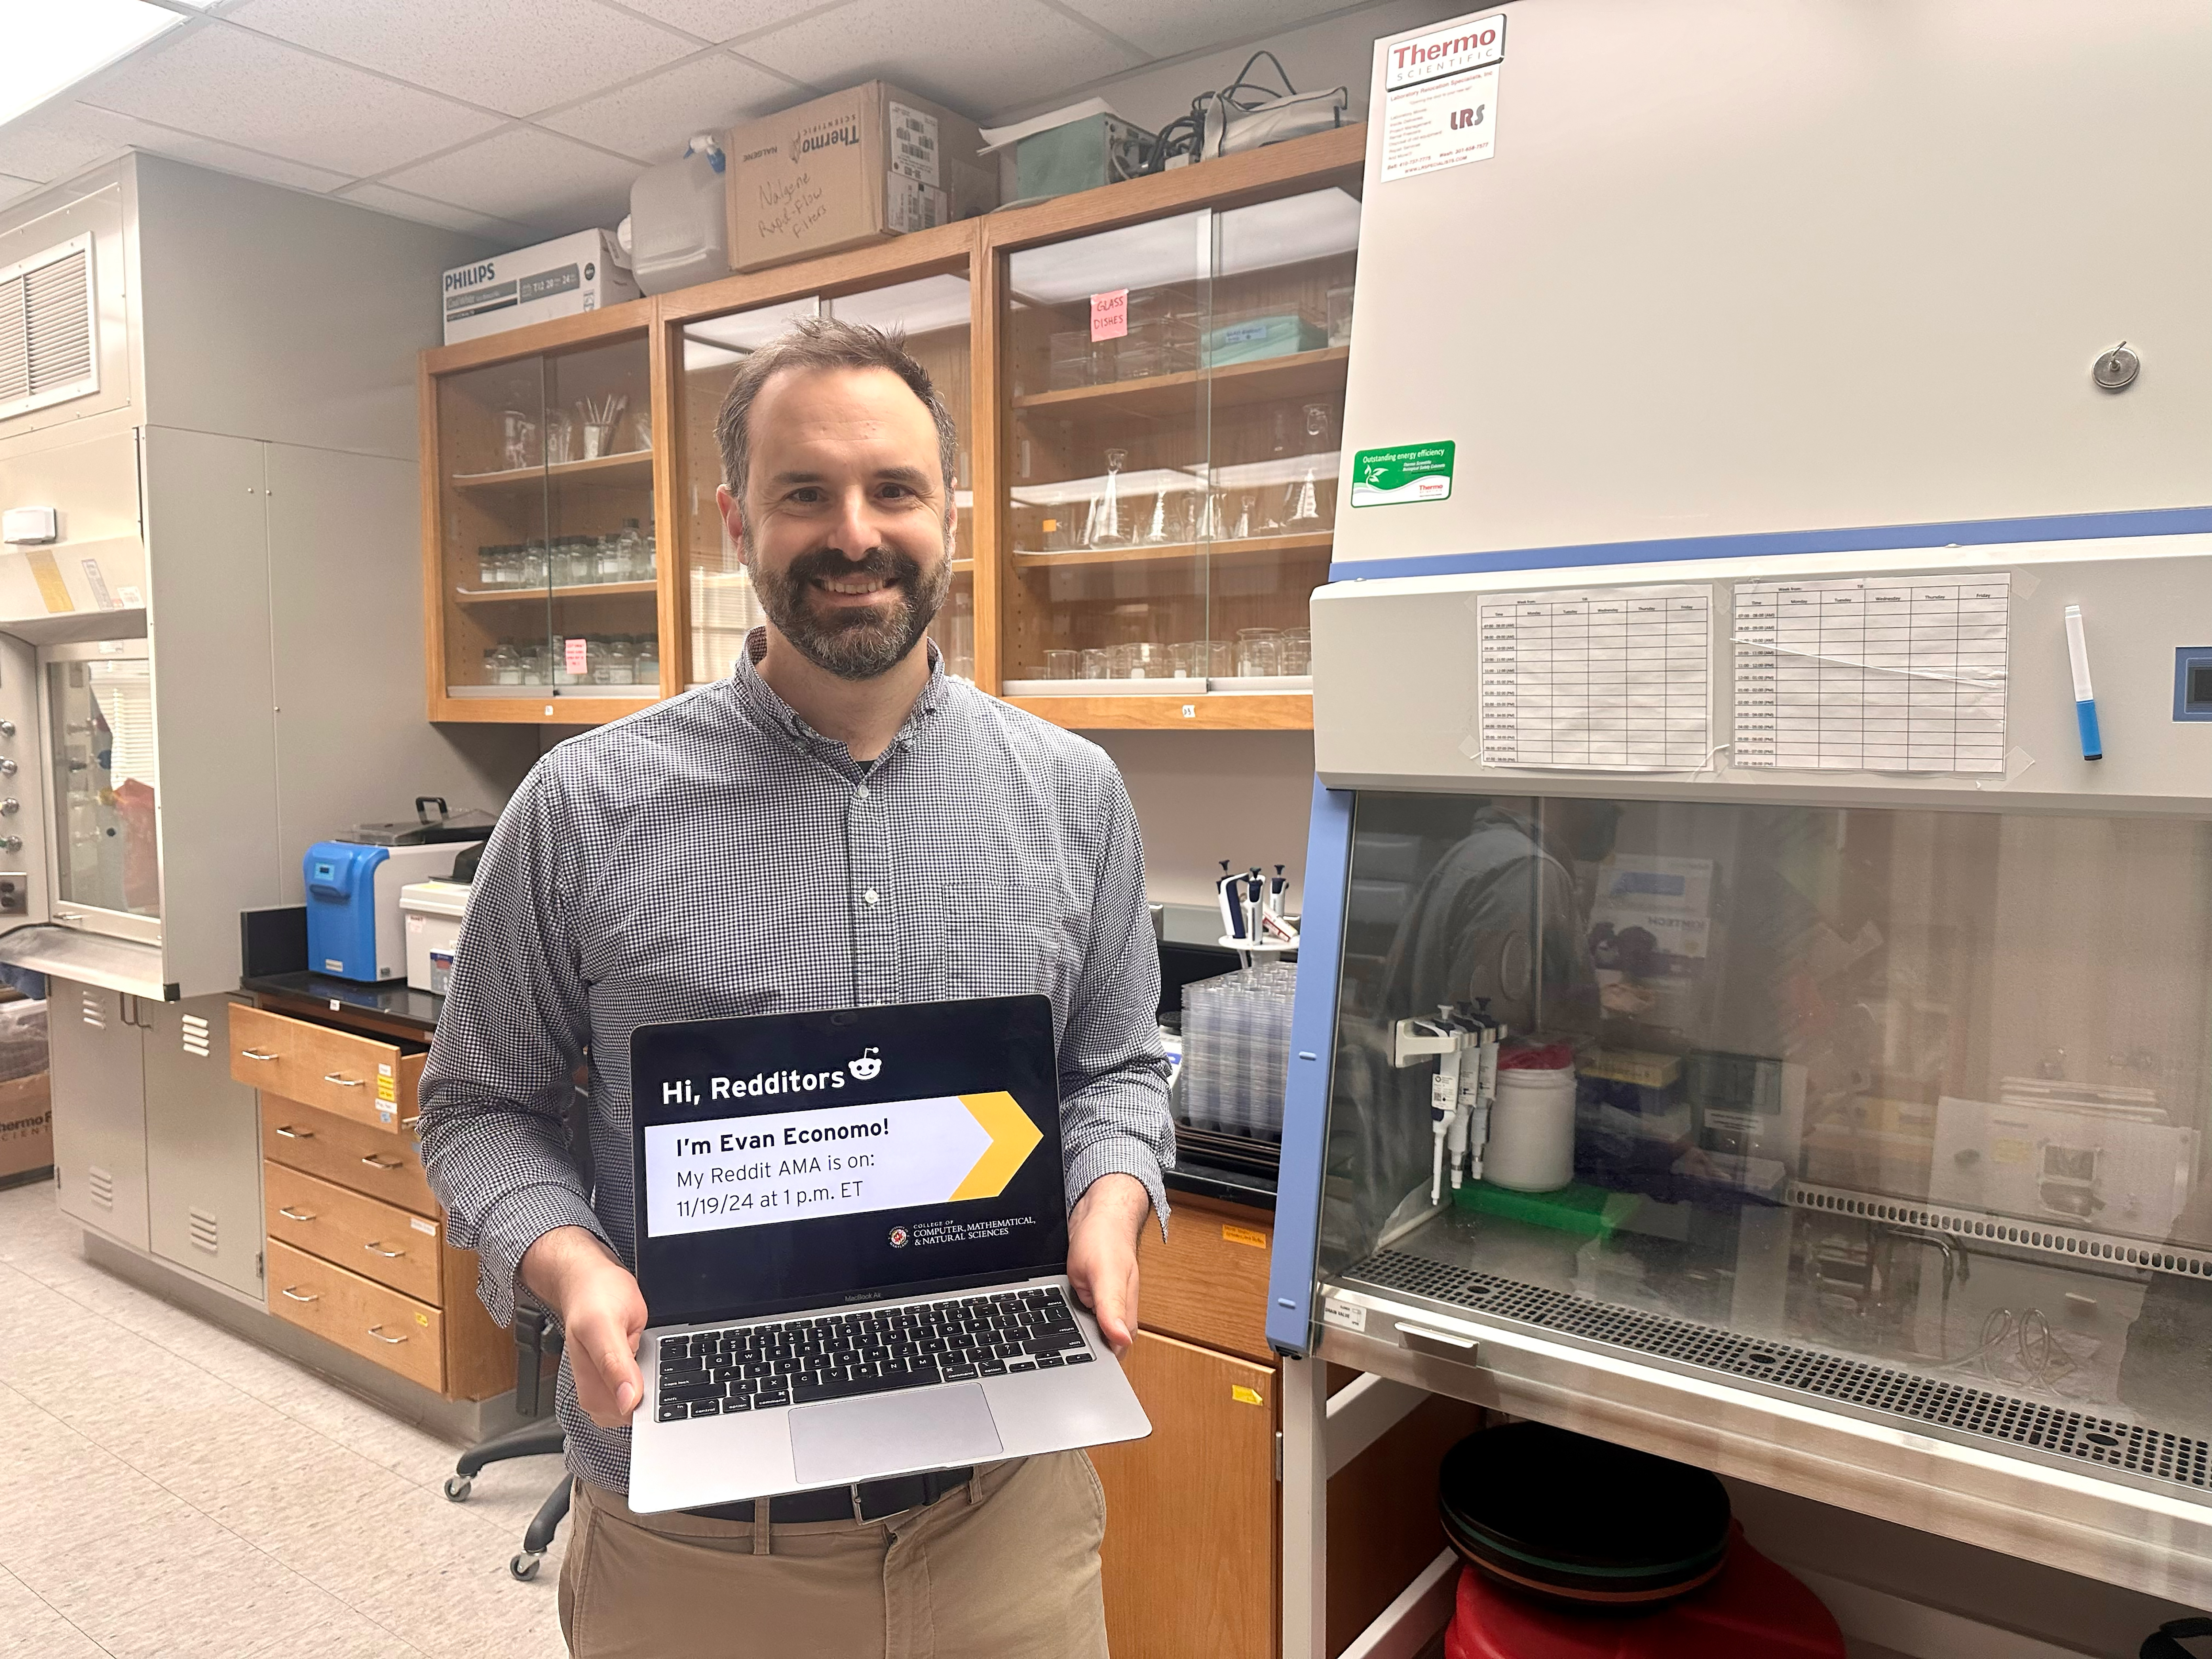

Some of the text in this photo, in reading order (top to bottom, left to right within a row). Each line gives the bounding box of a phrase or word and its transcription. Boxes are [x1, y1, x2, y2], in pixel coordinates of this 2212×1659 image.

[1394, 29, 1496, 69] Thermo
[1397, 49, 1493, 81] SCIENTIFIC
[1391, 91, 1419, 101] Laboratory
[1421, 83, 1449, 93] Relocation
[804, 114, 856, 135] SCIENTIFIC
[1451, 104, 1485, 130] LRS
[744, 125, 859, 162] NALGENE Thermo
[445, 263, 495, 291] PHILIPS
[1097, 296, 1123, 311] GLASS
[1094, 315, 1123, 329] DISHES
[1363, 453, 1396, 463] Outstanding
[1417, 449, 1445, 457] efficiency
[663, 1069, 845, 1105] Hi, Redditors
[677, 1118, 889, 1156] I'm Evan Economo!
[677, 1154, 875, 1190] My Reddit AMA is on:
[677, 1181, 863, 1217] 11/19/24 at 1 p.m. ET
[914, 1217, 1036, 1237] COMPUTER, MATHEMATICAL,
[922, 1233, 966, 1245] NATURAL
[968, 1228, 1009, 1239] SCIENCES
[845, 1293, 872, 1302] MacBook
